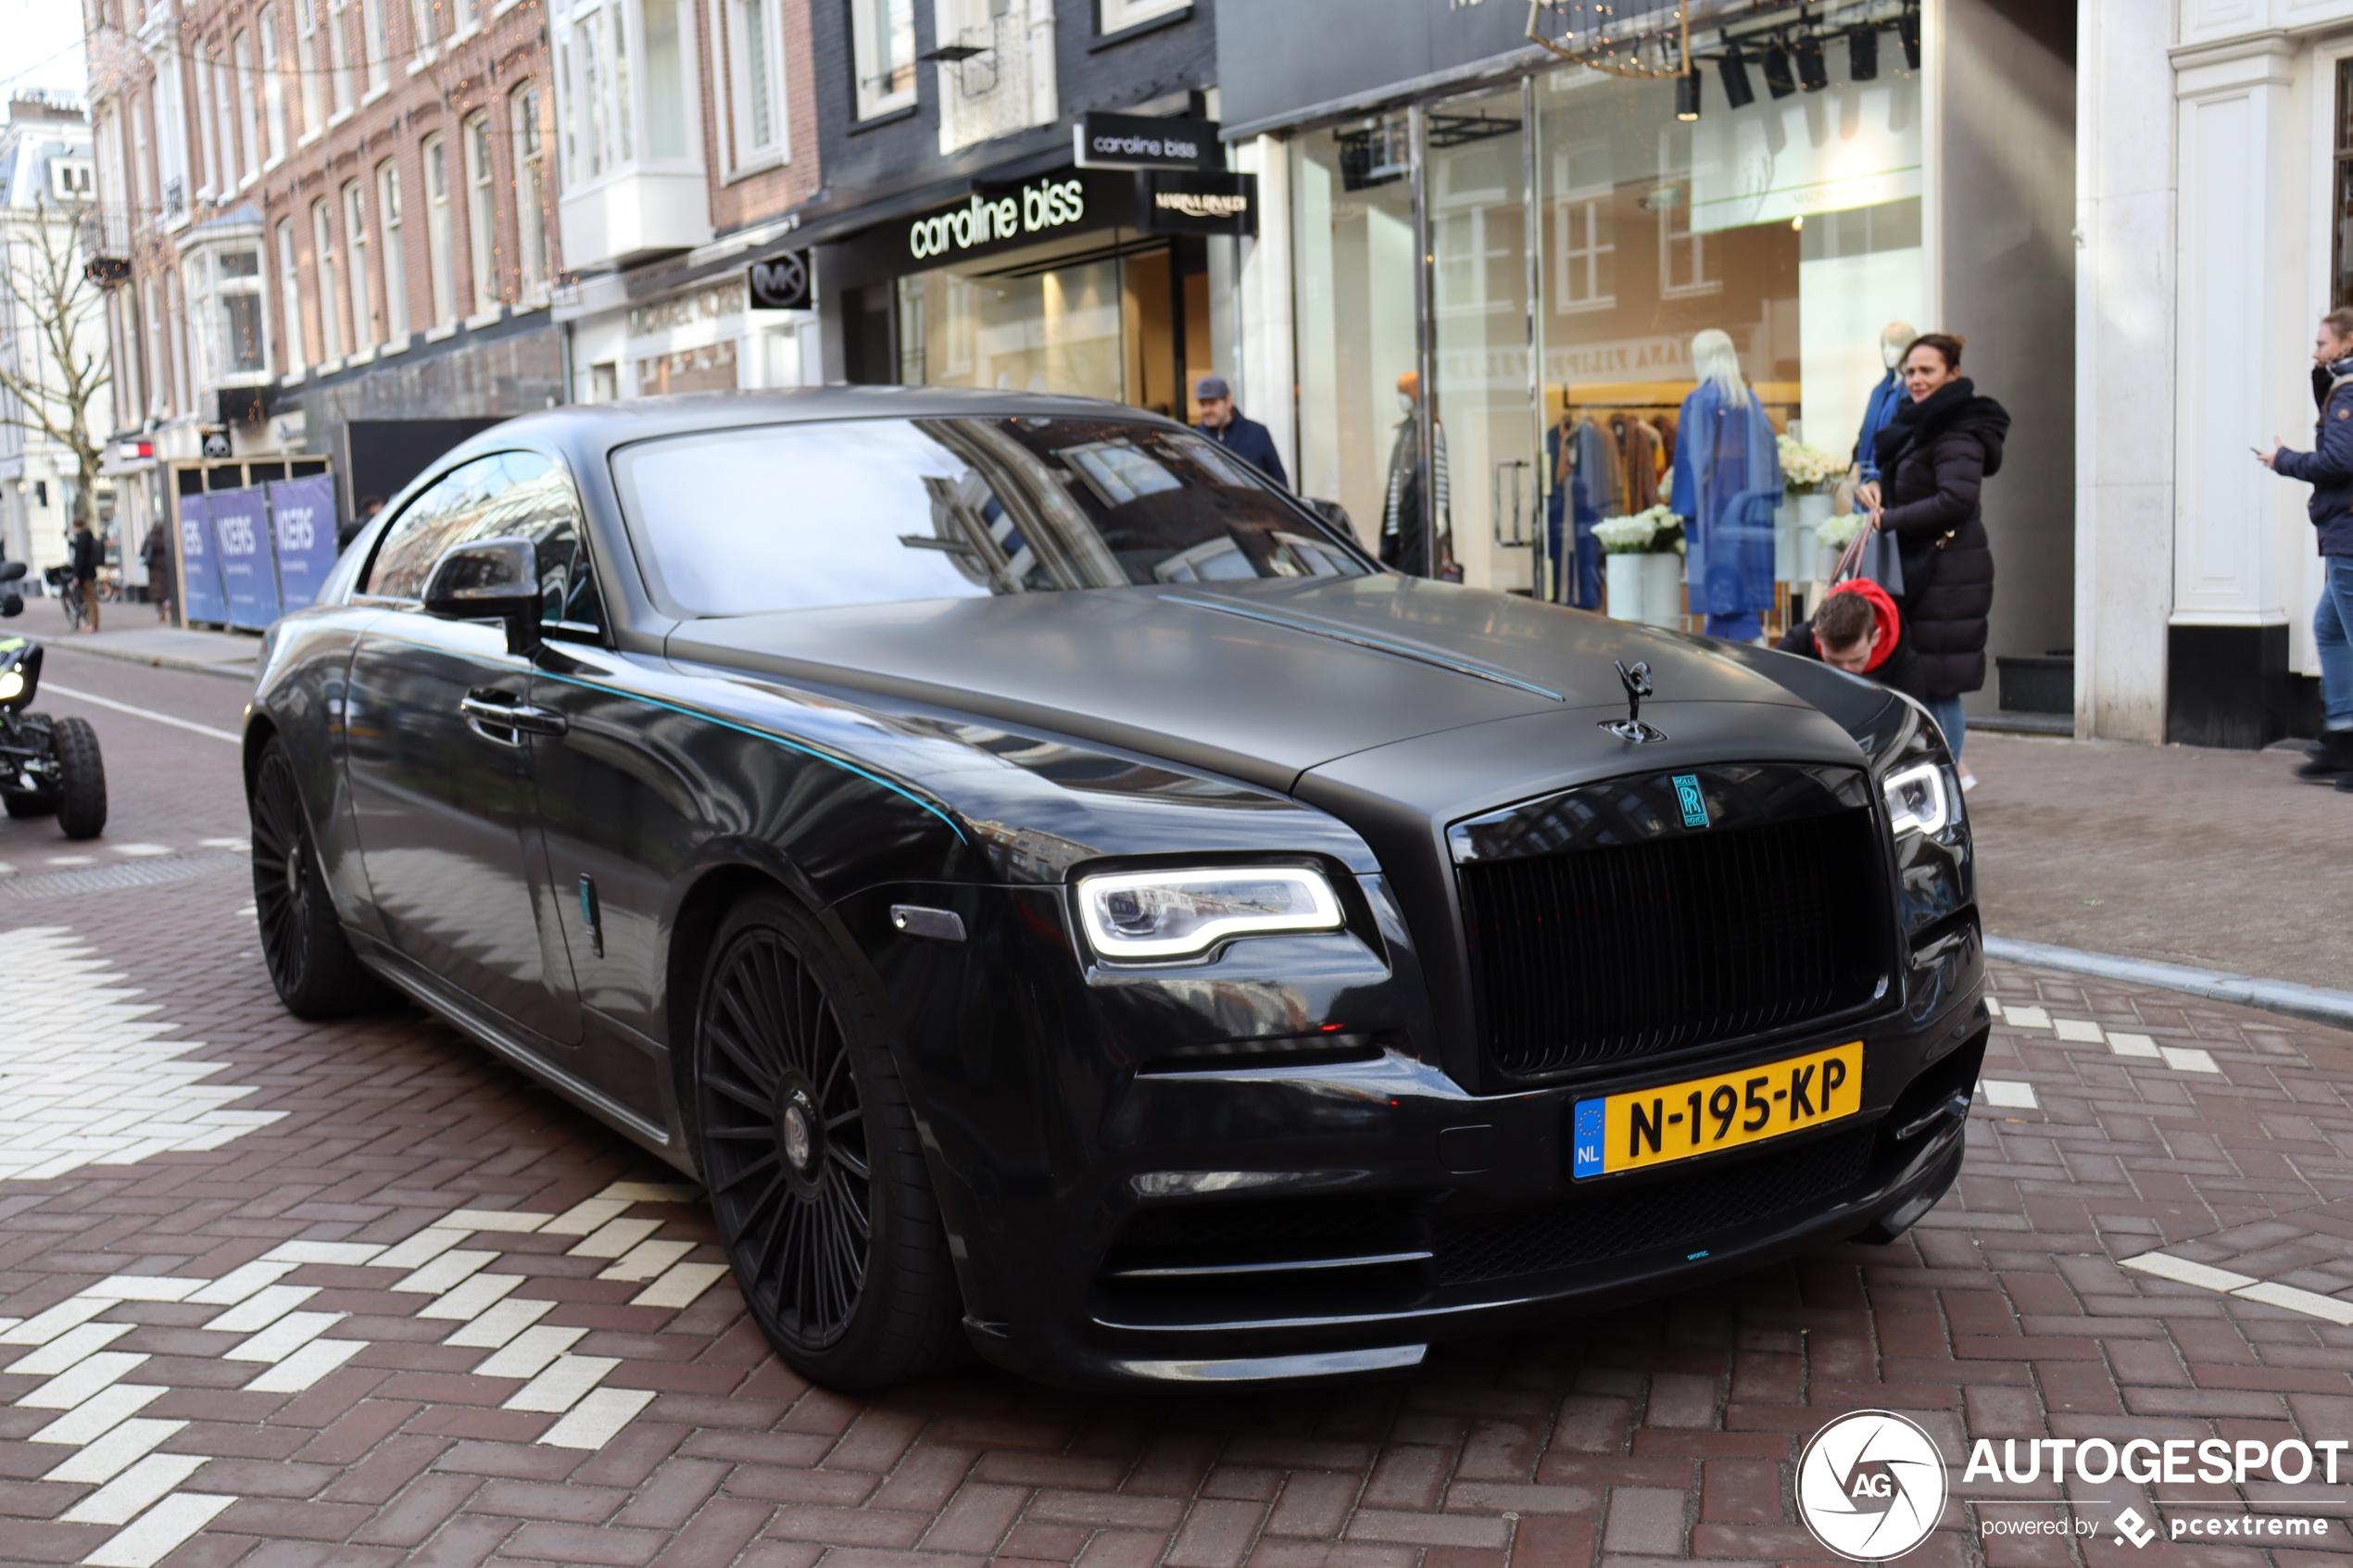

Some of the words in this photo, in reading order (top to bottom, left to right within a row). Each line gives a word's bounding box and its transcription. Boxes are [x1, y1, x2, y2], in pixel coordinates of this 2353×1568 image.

[1093, 136, 1162, 157] caroline
[1164, 139, 1198, 158] biss
[911, 194, 1018, 259] caroline
[1024, 178, 1084, 232] biss
[755, 263, 799, 293] MK
[1629, 1058, 1846, 1157] N-195-KP
[1578, 1146, 1600, 1164] NL
